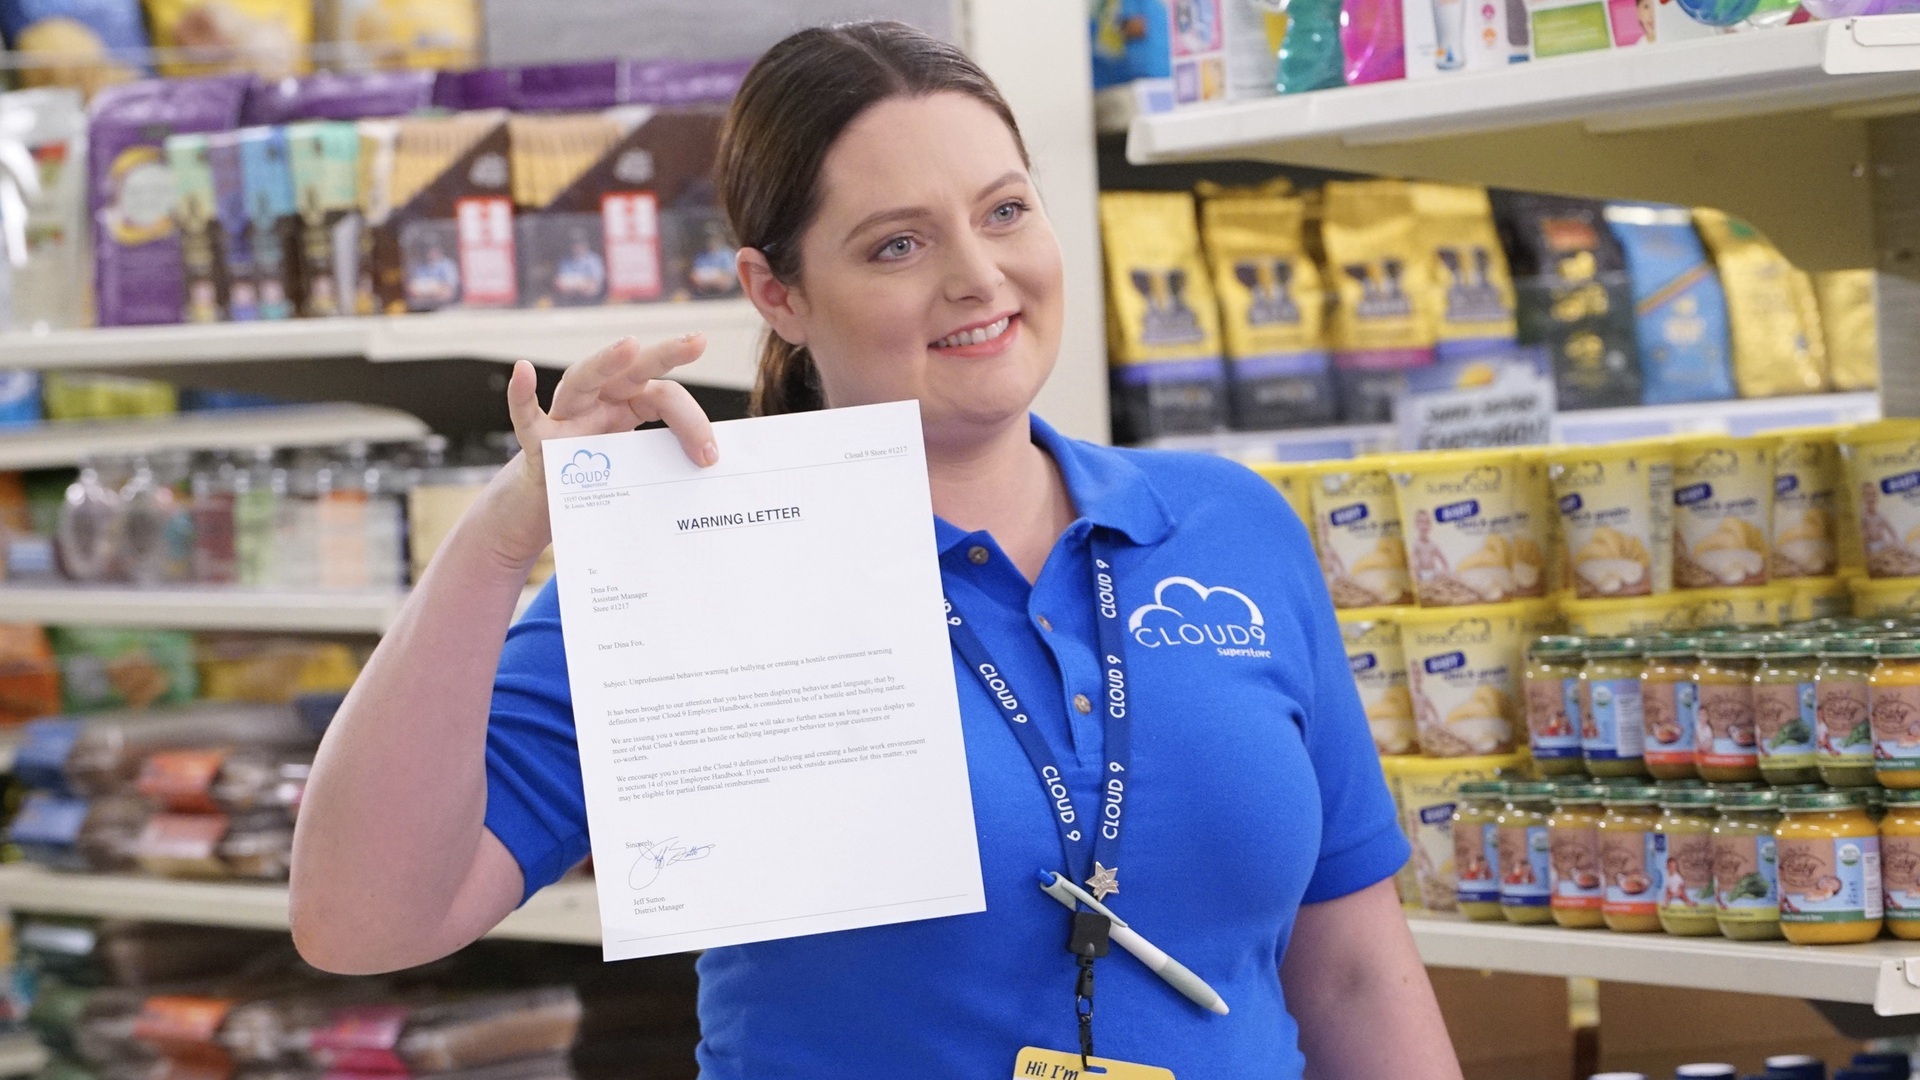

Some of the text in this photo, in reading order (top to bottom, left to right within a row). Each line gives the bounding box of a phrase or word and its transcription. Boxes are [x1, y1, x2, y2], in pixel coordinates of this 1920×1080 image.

[844, 451, 864, 459] Cloud
[888, 446, 907, 454] #1217
[561, 470, 610, 485] CLOUD9
[677, 506, 800, 530] WARNING LETTER
[592, 592, 648, 603] Assistant Manager
[1095, 559, 1117, 619] CLOUD 9
[610, 602, 629, 610] #1217
[1134, 624, 1267, 648] CLOUD9
[629, 673, 676, 686] Unprofessional
[704, 668, 729, 676] warning
[740, 664, 766, 672] bullying
[805, 656, 826, 664] hostile
[827, 651, 866, 661] environment
[867, 648, 893, 656] warning
[1216, 647, 1272, 659] Superstore
[640, 704, 665, 712] brought
[685, 699, 712, 707] attention
[725, 696, 737, 704] you
[770, 688, 802, 697] displaying
[802, 684, 829, 692] behavior
[831, 681, 842, 689] and
[887, 675, 895, 683] by
[978, 663, 1028, 724] CLOUD 9
[1107, 655, 1125, 719] CLOUD 9
[608, 718, 638, 726] definition
[646, 715, 660, 723] your
[662, 711, 681, 719] Cloud
[688, 708, 718, 716] Employee
[760, 697, 793, 707] considered
[823, 691, 844, 699] hostile
[858, 687, 884, 695] bullying
[656, 734, 668, 742] you
[674, 729, 699, 737] warning
[796, 714, 816, 722] further
[883, 703, 905, 711] display
[653, 741, 672, 749] Cloud
[707, 734, 728, 742] hostile
[736, 731, 762, 739] bullying
[763, 728, 790, 736] language
[799, 723, 826, 731] behavior
[835, 720, 850, 729] your
[850, 716, 882, 724] customers
[628, 773, 658, 781] encourage
[659, 771, 672, 779] you
[680, 766, 702, 774] re-read
[713, 762, 732, 770] Cloud
[739, 759, 768, 767] definition
[777, 754, 803, 762] bullying
[847, 745, 868, 753] hostile
[870, 742, 886, 750] work
[887, 738, 926, 748] environment
[665, 780, 679, 788] your
[680, 776, 710, 784] Employee
[753, 769, 765, 777] you
[765, 765, 780, 773] need
[804, 760, 826, 768] outside
[828, 757, 858, 765] assistance
[905, 749, 918, 757] you
[642, 790, 664, 799] eligible
[676, 786, 696, 796] partial
[697, 782, 723, 791] financial
[1041, 765, 1081, 841] CLOUD 9
[1102, 762, 1125, 840] CLOUD 9
[634, 898, 644, 906] Jeff
[634, 904, 684, 915] District Manager
[1025, 1061, 1080, 1080] Hi! I'm
